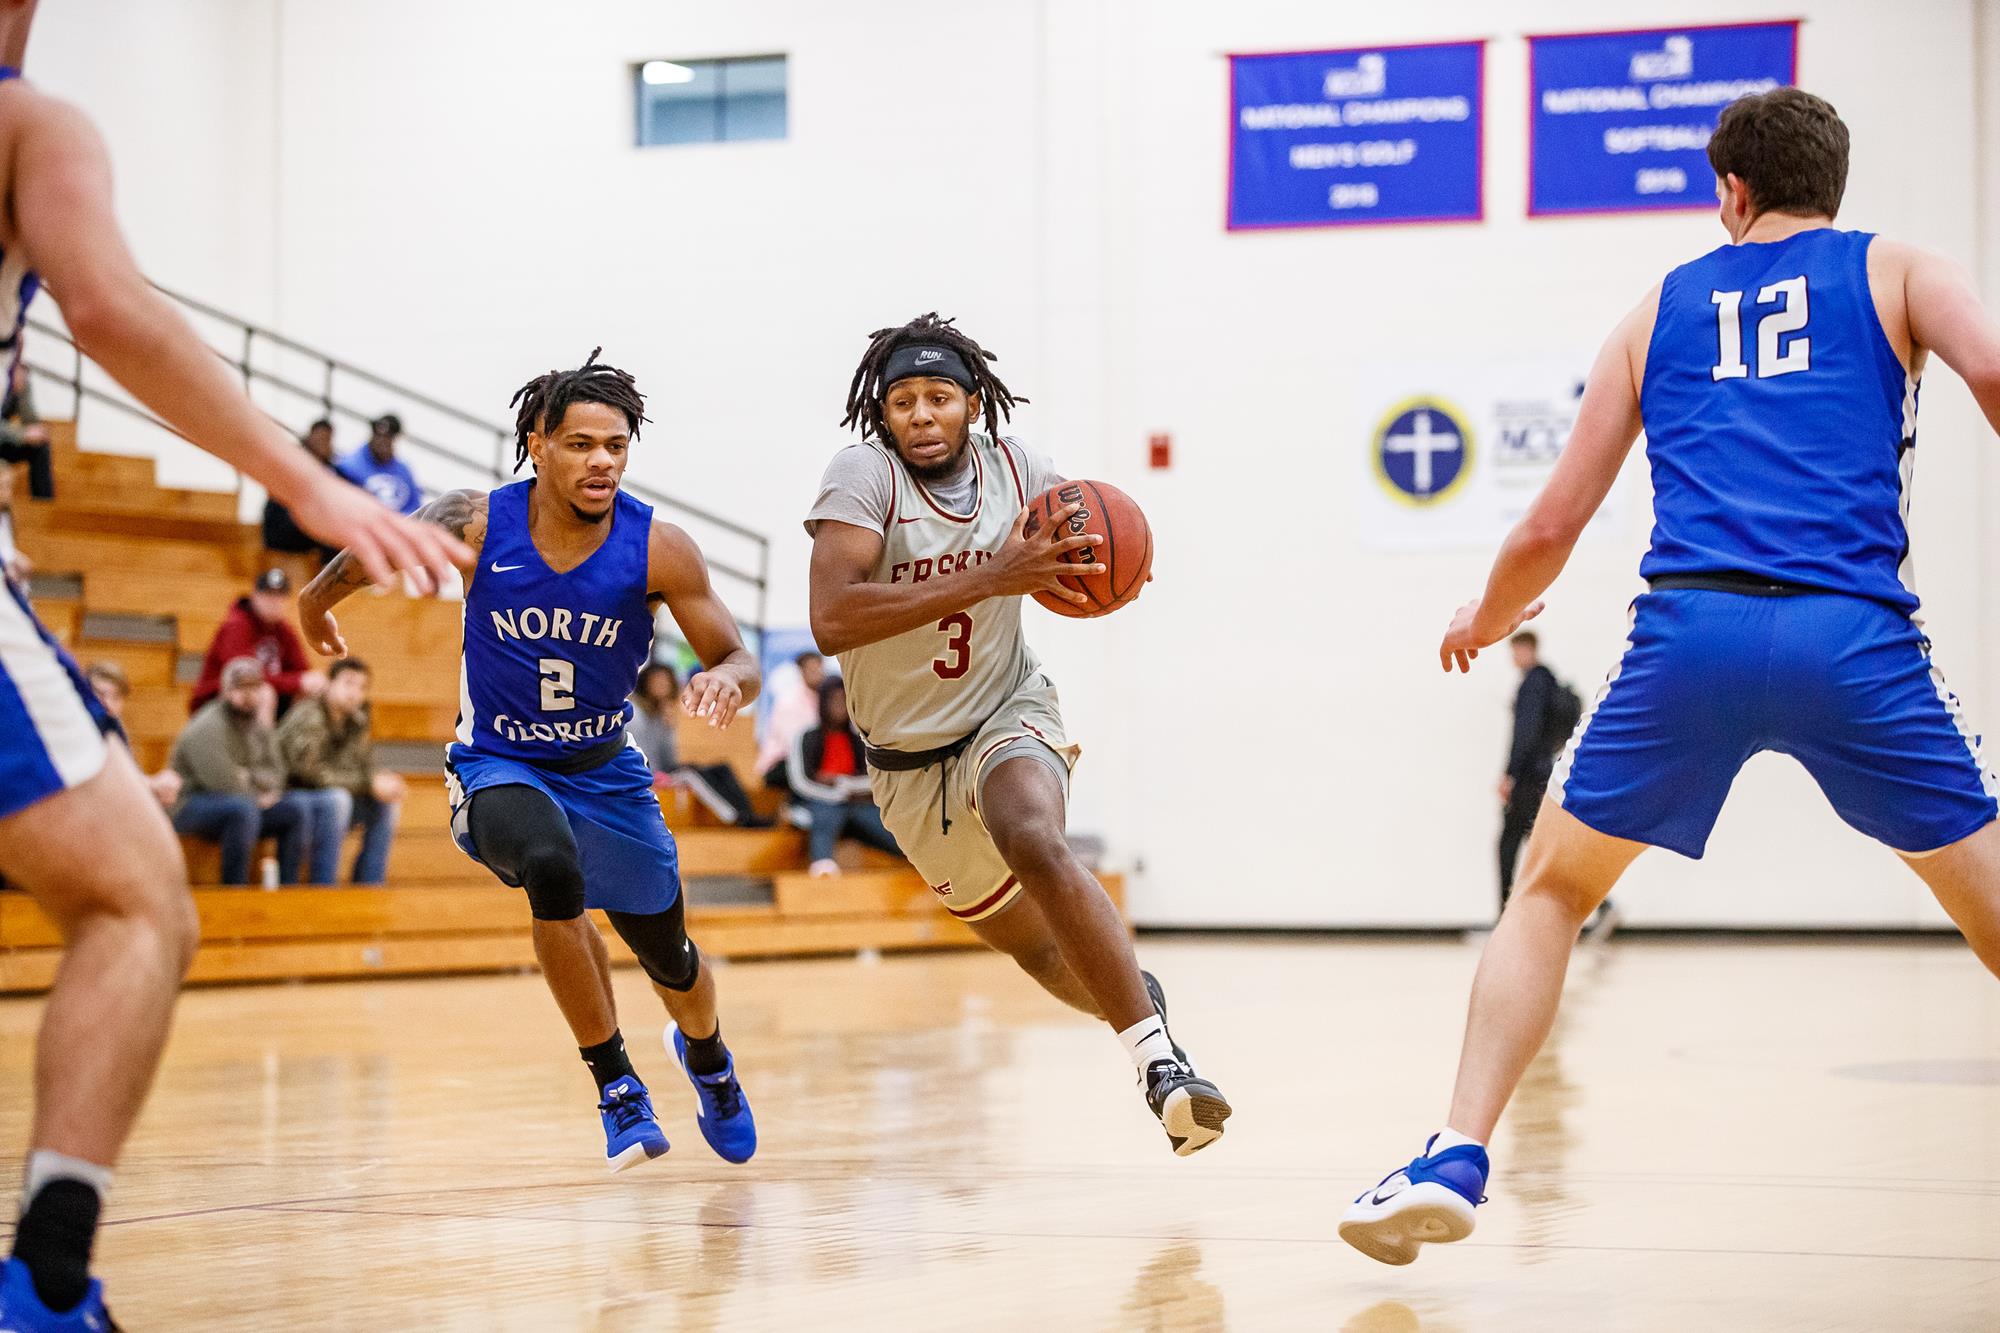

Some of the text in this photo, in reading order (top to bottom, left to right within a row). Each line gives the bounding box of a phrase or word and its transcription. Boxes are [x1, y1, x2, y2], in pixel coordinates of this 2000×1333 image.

[1241, 98, 1469, 128] NATIONAL CHAMPIONS
[1544, 88, 1647, 113] NATIONAL
[1358, 140, 1417, 166] GOLF
[1711, 275, 1810, 382] 12
[920, 350, 942, 360] RUN
[890, 550, 993, 584] ERSKI
[490, 606, 623, 648] NORTH
[932, 609, 974, 681] 3
[538, 658, 576, 712] 2
